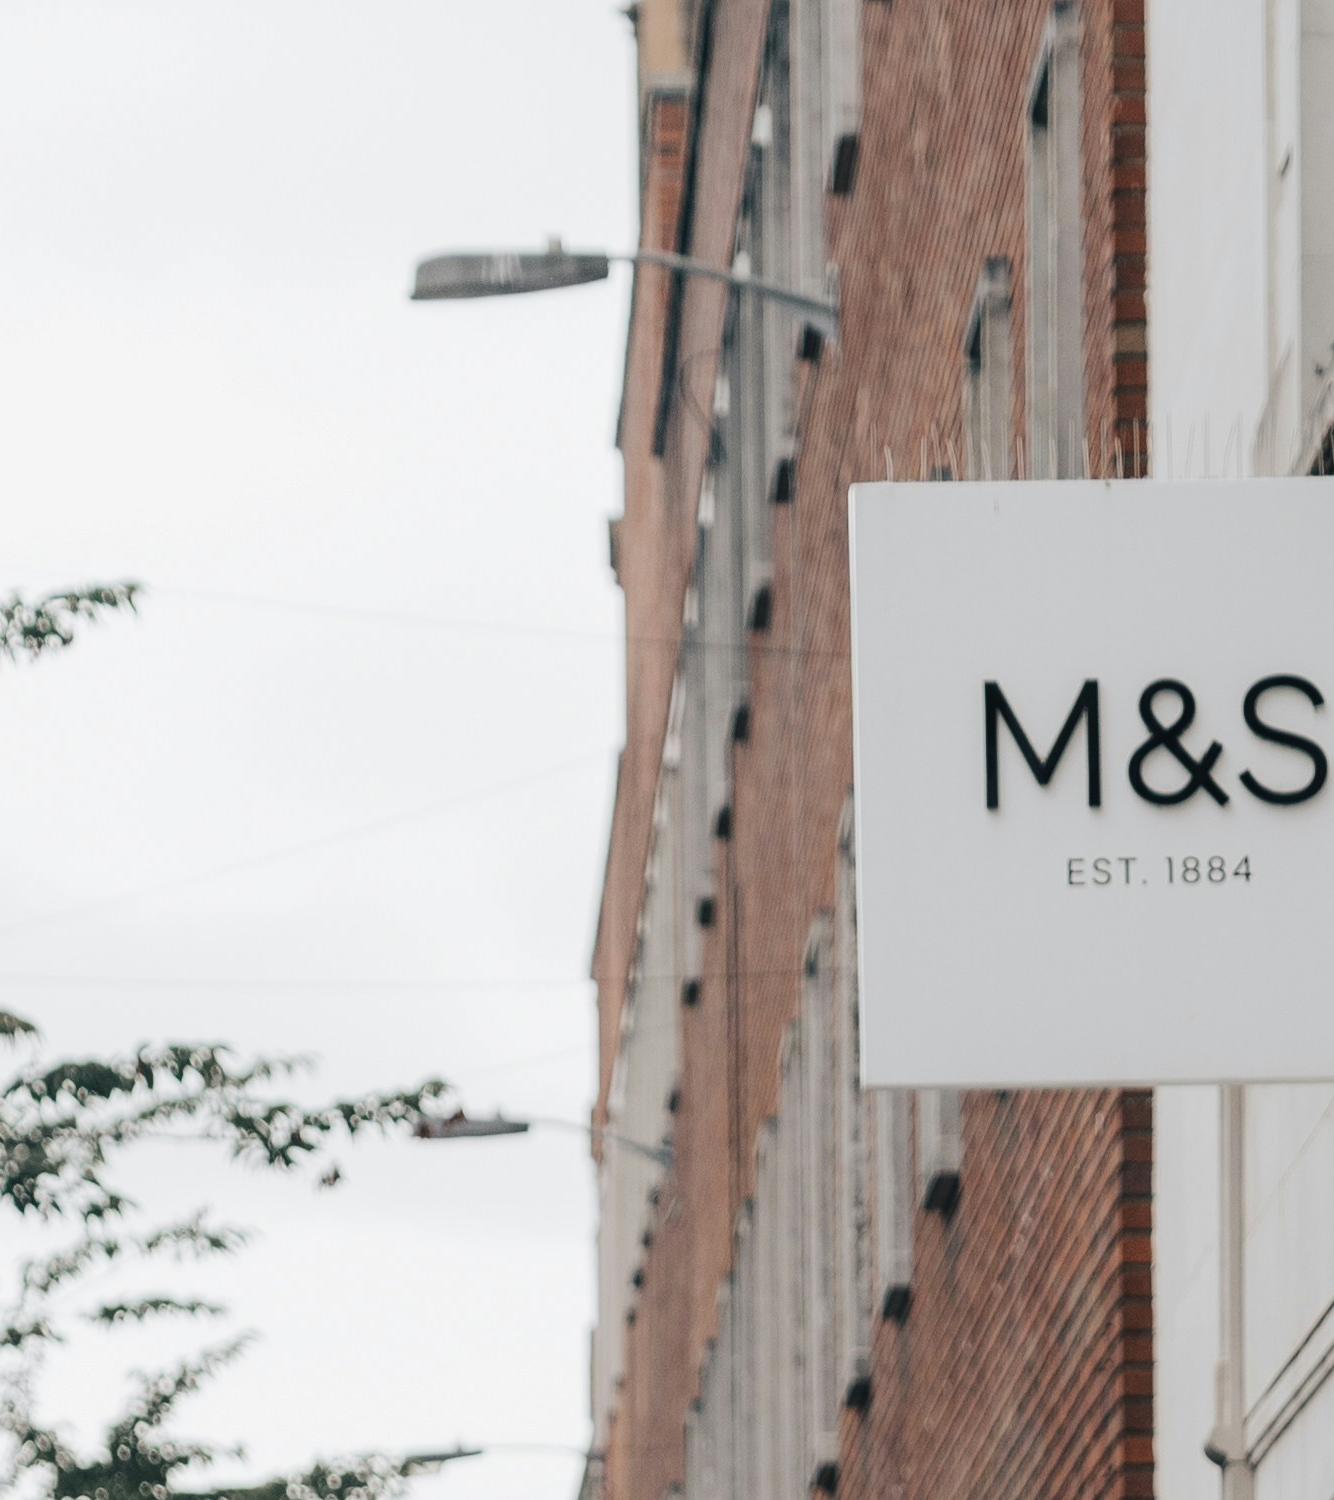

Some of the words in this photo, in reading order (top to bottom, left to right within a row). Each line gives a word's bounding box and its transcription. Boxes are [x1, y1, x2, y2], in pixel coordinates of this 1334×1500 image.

[983, 674, 1329, 812] M&S
[1066, 857, 1148, 886] EST.
[1165, 855, 1253, 884] 1884
